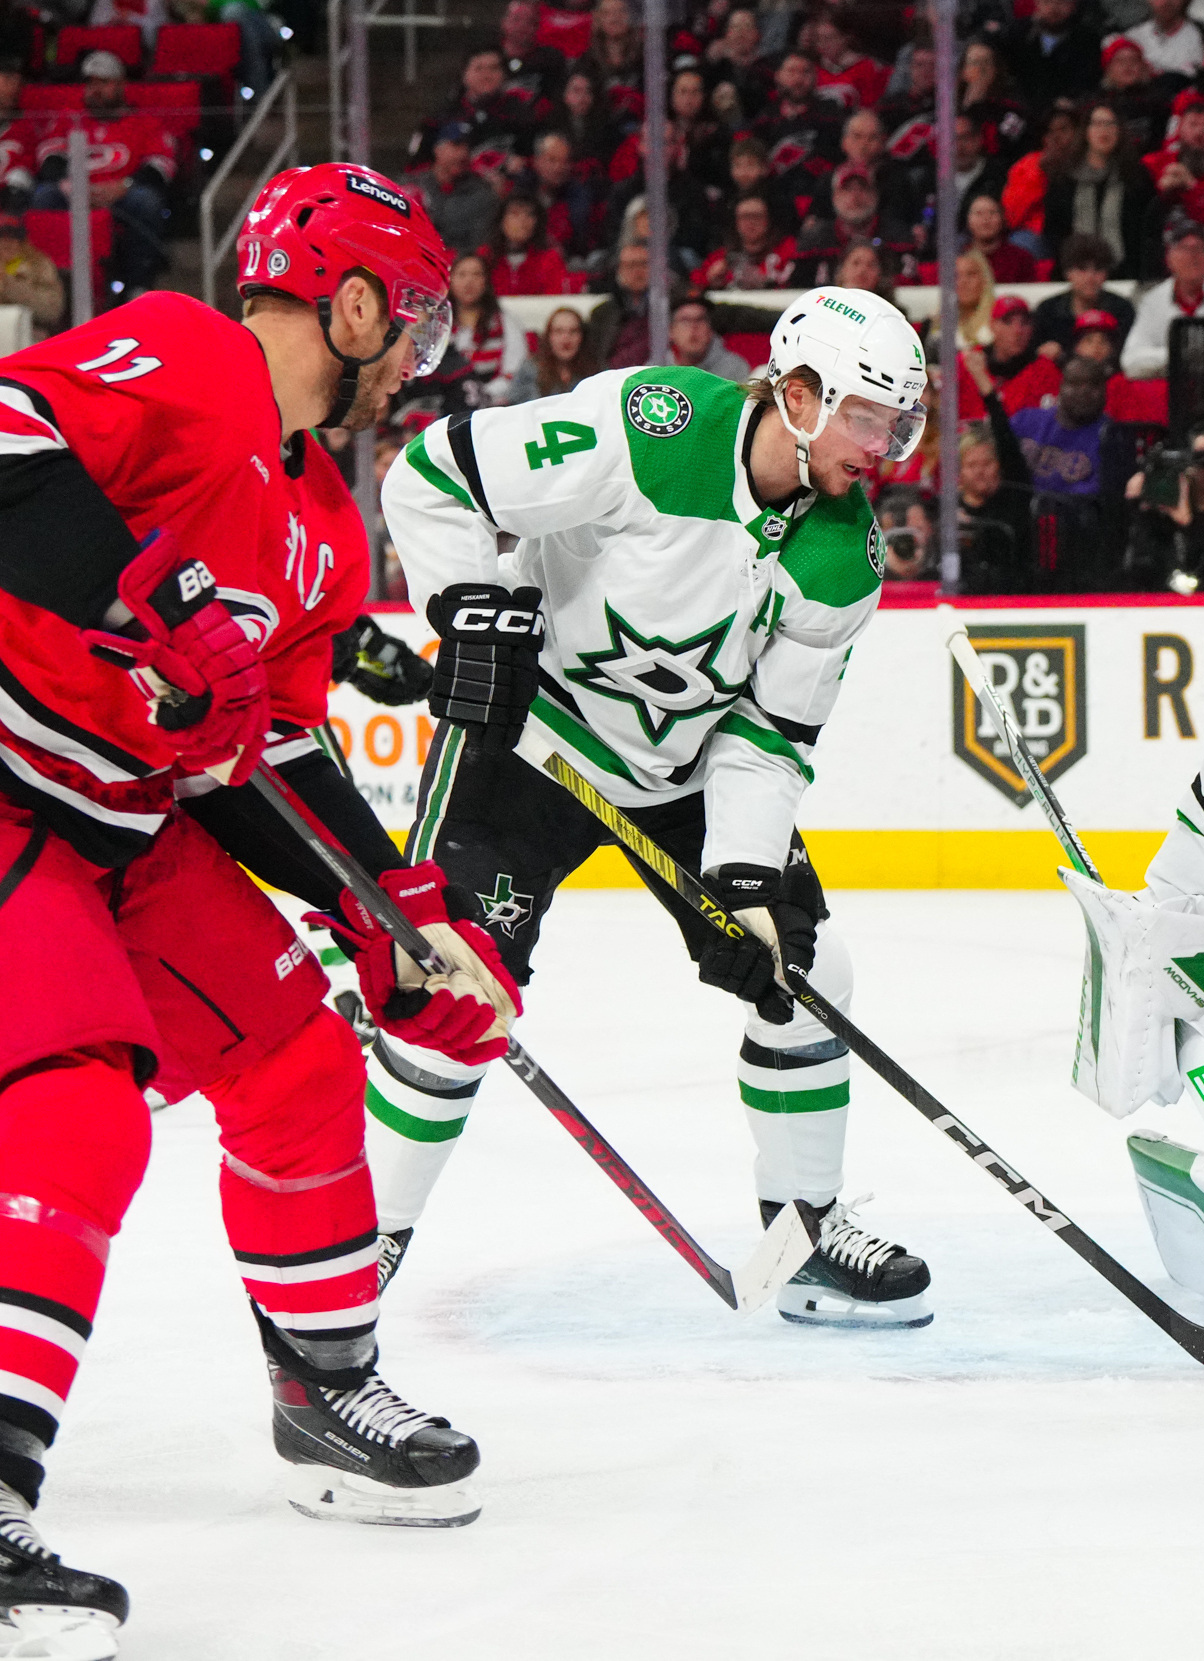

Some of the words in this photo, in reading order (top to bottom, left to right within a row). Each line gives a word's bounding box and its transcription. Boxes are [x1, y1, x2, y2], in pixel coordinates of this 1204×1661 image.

[350, 177, 407, 211] Lenovo
[246, 242, 261, 276] 11
[76, 337, 164, 384] 11
[912, 344, 922, 364] 4
[525, 421, 597, 470] 4
[461, 593, 490, 601] HEISKANEN
[732, 879, 763, 887] CCM
[787, 963, 808, 980] CC
[811, 1003, 828, 1020] PRO
[932, 1114, 1072, 1232] CCM
[324, 1431, 371, 1462] BAUER
